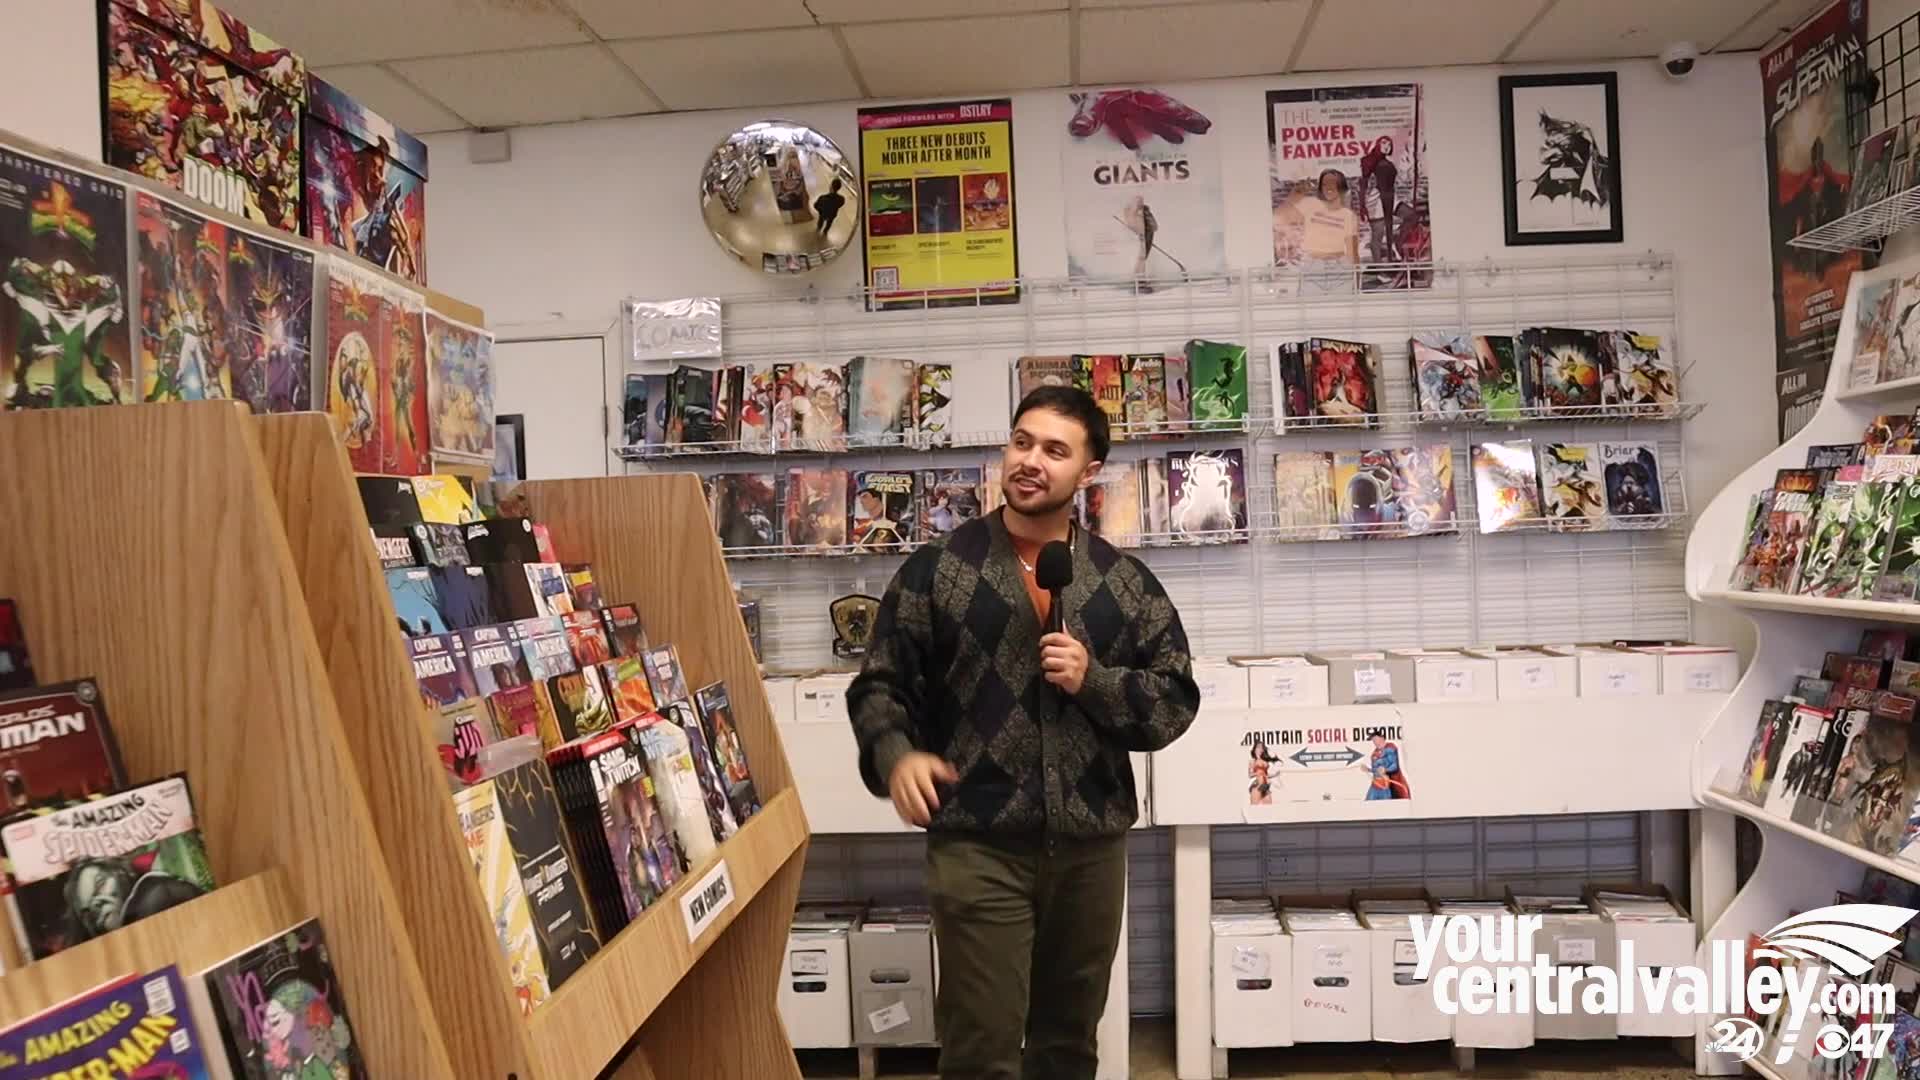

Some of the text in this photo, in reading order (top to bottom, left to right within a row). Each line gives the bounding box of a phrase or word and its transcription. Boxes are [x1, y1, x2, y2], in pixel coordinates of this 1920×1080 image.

[1770, 34, 1865, 129] SUPERMAN
[960, 103, 992, 119] DSTLRY
[886, 130, 986, 150] THREE NEW DEBUTS
[1281, 124, 1356, 143] POWER
[881, 145, 991, 165] MONTH AFTER MONTH
[1282, 139, 1374, 161] FANTASY
[1093, 160, 1191, 185] GIANTS
[183, 156, 245, 217] DOOM
[1132, 358, 1162, 371] Archie
[1604, 444, 1634, 458] Briar
[413, 636, 442, 652] CAPTAIN
[474, 627, 500, 642] CAPTAIN
[413, 655, 457, 679] AMERICA
[471, 645, 513, 669] AMERICA
[1307, 728, 1348, 744] SOCIAL
[71, 792, 145, 829] AMAZING
[43, 801, 173, 864] SPIDER-MAN
[689, 874, 727, 924] NEW COMICS
[25, 1000, 131, 1065] AMAZING
